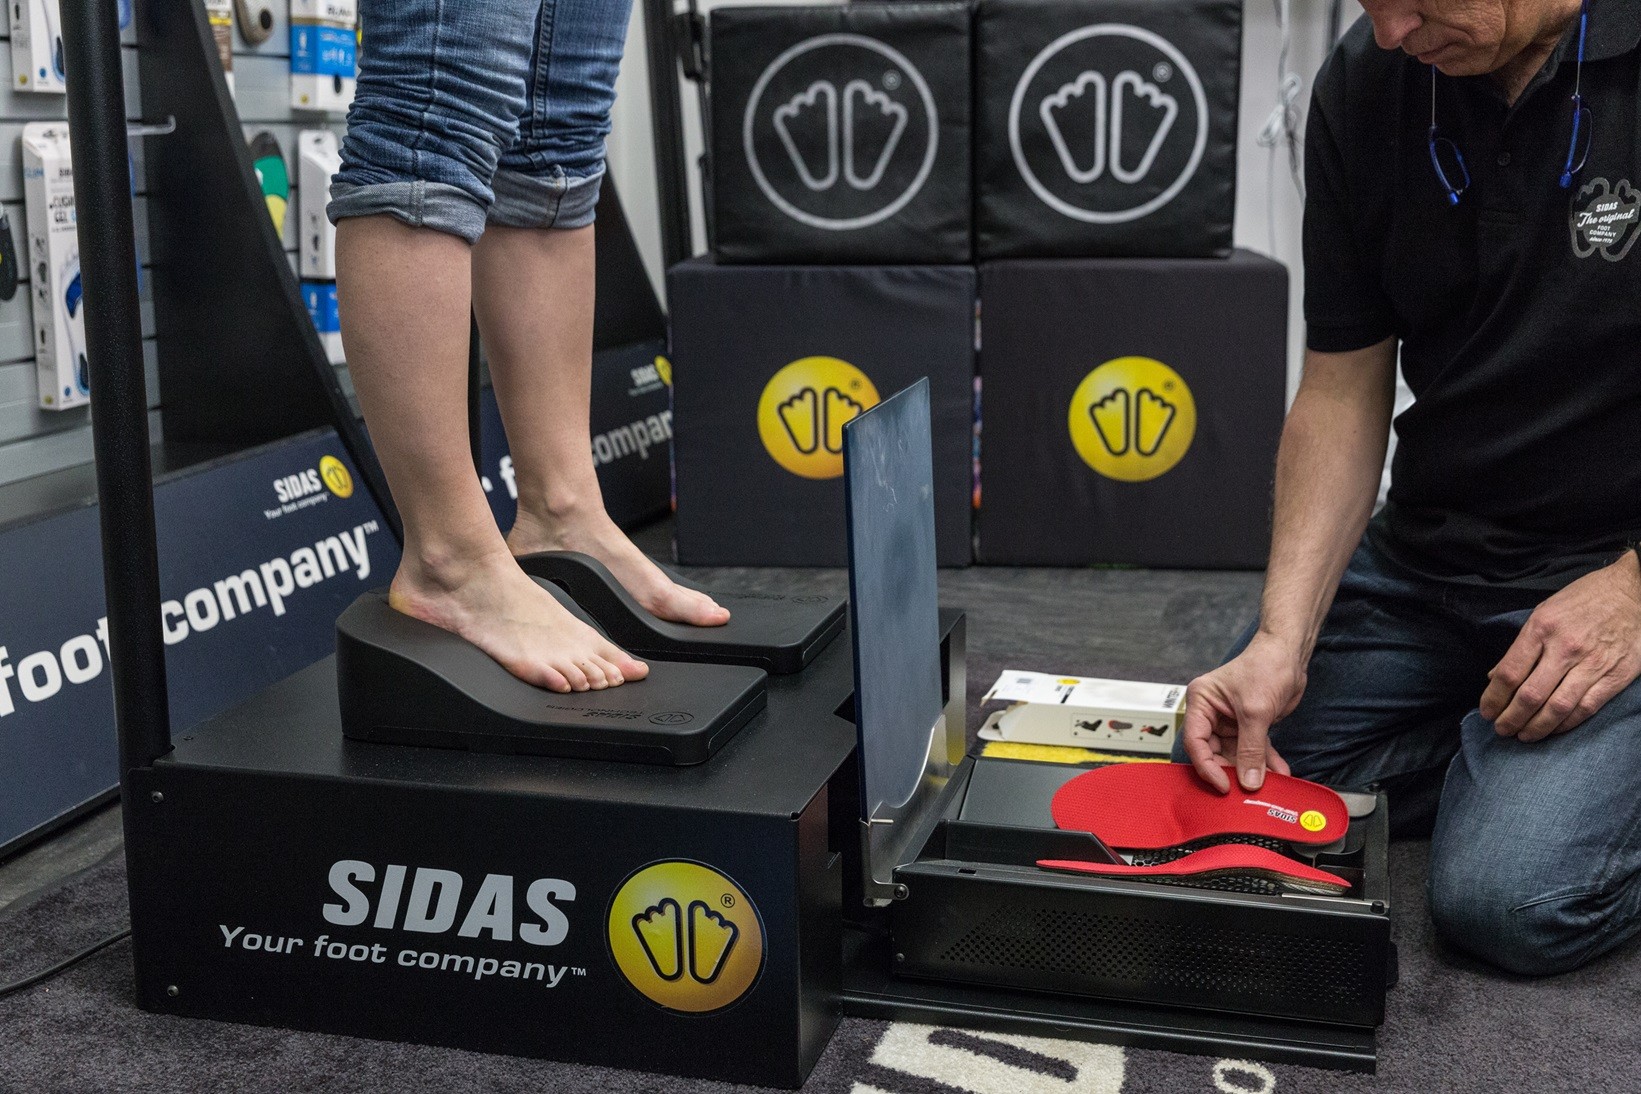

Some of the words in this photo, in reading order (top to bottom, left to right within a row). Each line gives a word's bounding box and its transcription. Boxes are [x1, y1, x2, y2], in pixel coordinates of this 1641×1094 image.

[1577, 212, 1598, 228] The
[1598, 208, 1635, 224] original
[1596, 202, 1618, 212] SIDAS
[273, 468, 322, 503] SIDAS
[1267, 808, 1298, 824] SIDAS
[322, 860, 577, 946] SIDAS
[219, 925, 304, 956] Your
[313, 935, 387, 964] foot
